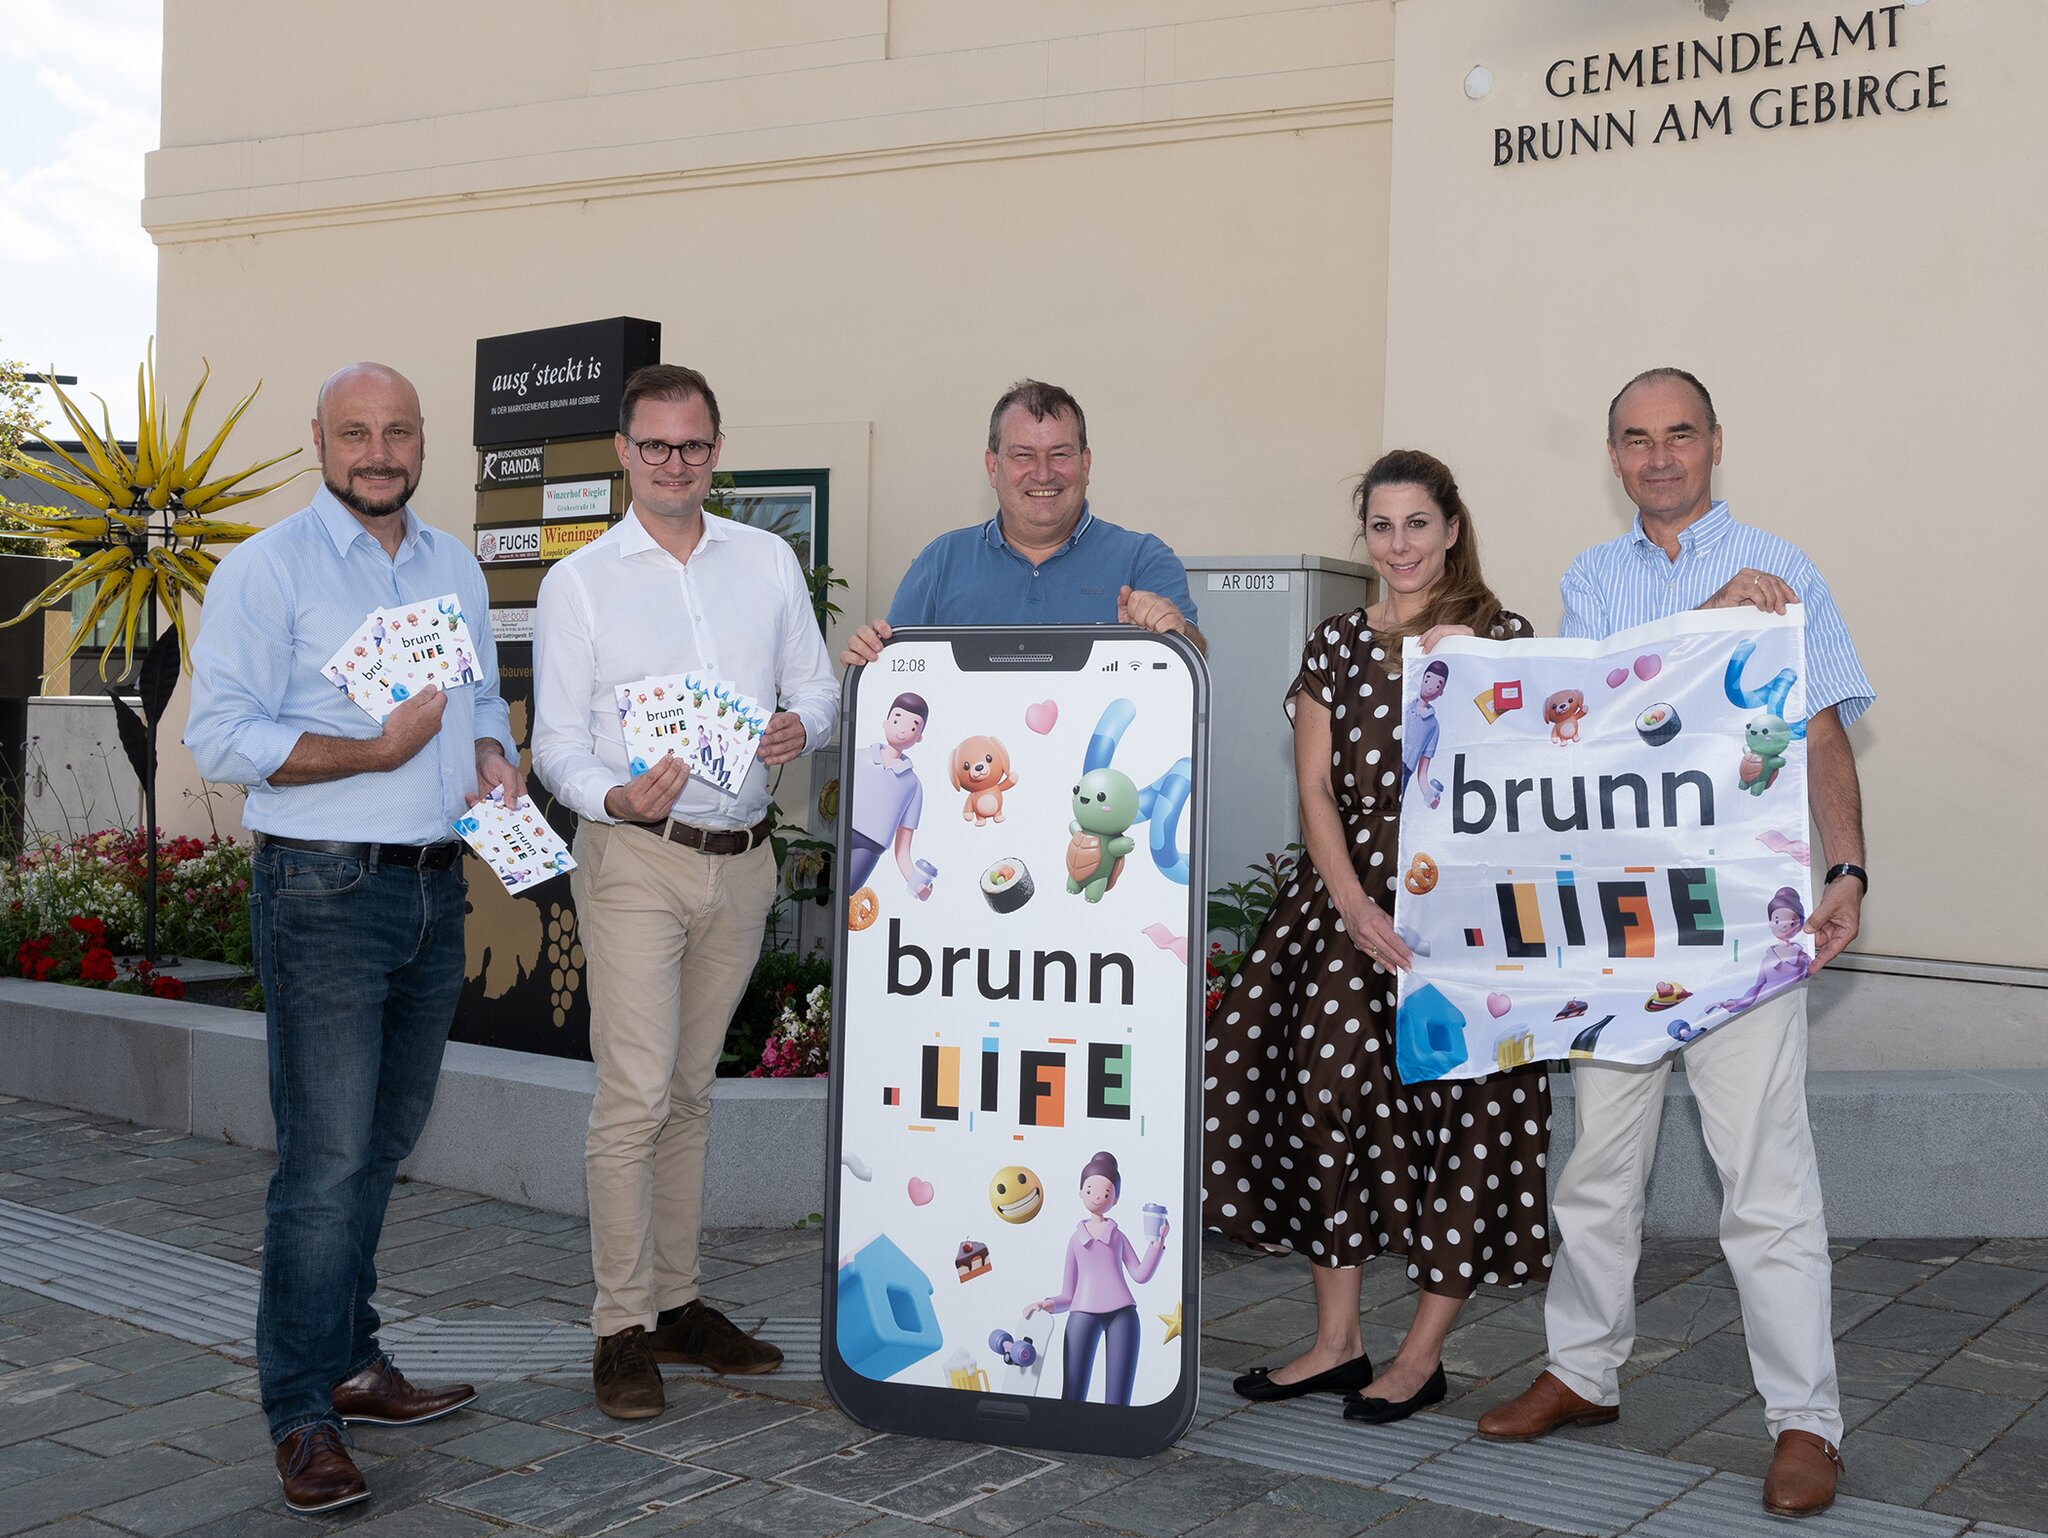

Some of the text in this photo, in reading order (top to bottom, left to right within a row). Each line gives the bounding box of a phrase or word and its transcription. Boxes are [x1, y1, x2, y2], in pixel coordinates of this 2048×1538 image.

[1545, 5, 1905, 98] GEMEINDEAMT
[1493, 65, 1949, 167] BRUNN AM GEBIRGE
[587, 356, 602, 380] is
[491, 395, 600, 415] IN DER MARKTGEMEINDE BRUNN AM GEBIRGE
[498, 446, 544, 459] BUSCHENSCHANK
[501, 457, 539, 475] RANDA
[546, 487, 607, 500] Winzerhof Riegler
[499, 533, 538, 551] FUCHS
[543, 525, 604, 544] Wieninger
[1221, 574, 1275, 590] AR 0013
[401, 631, 440, 648] brunn
[891, 658, 926, 672] 12:08
[646, 706, 684, 722] brunn
[1452, 753, 1715, 835] brunn
[512, 824, 537, 856] brunn
[887, 917, 1134, 1005] brunn
